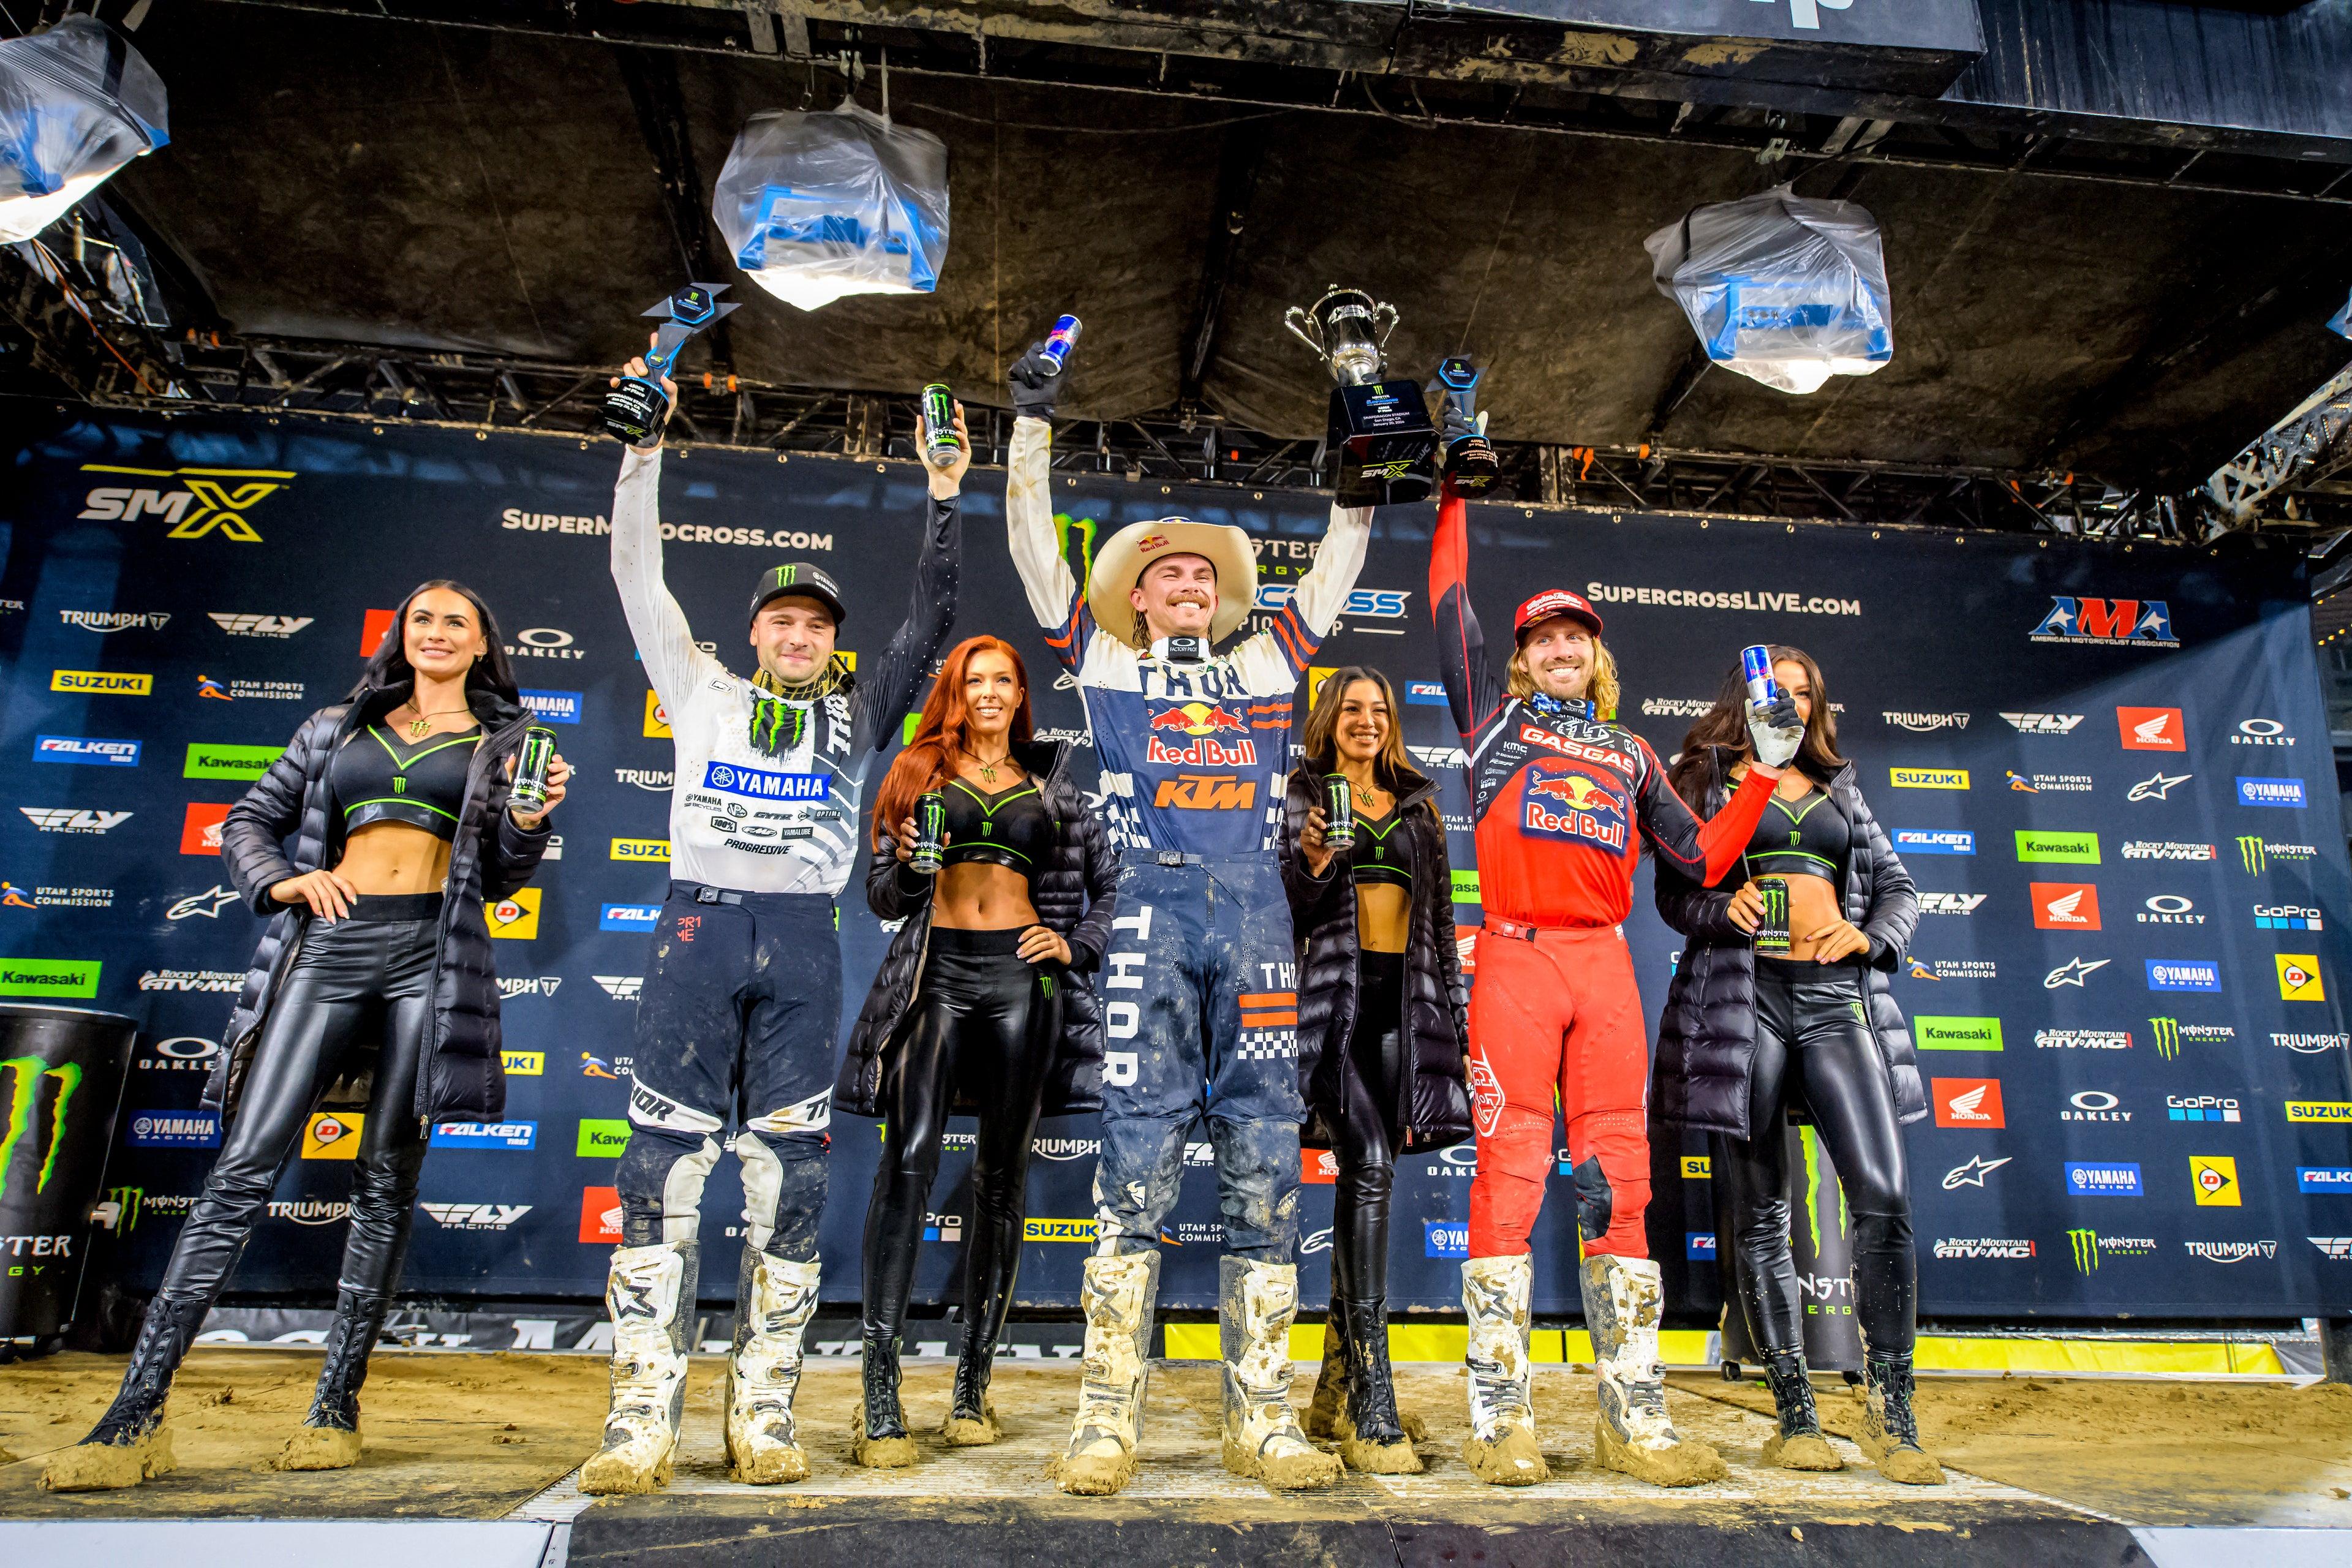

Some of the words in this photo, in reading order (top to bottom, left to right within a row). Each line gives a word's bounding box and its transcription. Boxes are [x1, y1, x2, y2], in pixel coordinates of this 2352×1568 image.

[633, 399, 652, 412] STADIUM
[1360, 464, 1411, 478] SMX
[1455, 478, 1490, 487] SMX
[77, 479, 279, 541] SMX
[502, 508, 833, 551] SUPERMOCROSS.COM
[61, 610, 146, 633] TRIUMPH
[207, 612, 315, 633] FLY
[2029, 596, 2180, 641] AMA
[2132, 639, 2180, 648] ASSOCIATION
[504, 646, 585, 660] OAKLEY
[59, 675, 143, 690] SUZUKI
[231, 680, 260, 690] UTAH
[264, 681, 304, 691] SPORTS
[1139, 664, 1249, 698] THOR
[230, 689, 303, 699] COMMISSION
[519, 696, 575, 712] YAMAHA
[1656, 698, 1684, 707] ROCKY
[1883, 712, 1953, 731] TRIUMPH
[1999, 712, 2084, 729] FLY
[1050, 727, 1081, 737] ROCKY
[40, 739, 137, 755] FALKEN
[1503, 741, 1528, 753] KMC
[2231, 735, 2296, 746] OAKLEY
[1148, 737, 1202, 766] Red
[1206, 739, 1257, 766] Bull
[1523, 727, 1634, 775] GASGAS
[198, 756, 271, 769] Kawasak
[615, 769, 674, 791] TRIUM
[737, 771, 823, 797] YAMAHA
[1896, 772, 1962, 784] SUZUKI
[1155, 775, 1256, 809] KTM
[2035, 783, 2092, 791] COMMISSION
[2256, 785, 2301, 797] YAMAHA
[693, 794, 722, 806] YAMAHA
[692, 803, 722, 812] BICYCLES
[19, 807, 134, 828] FLY
[753, 812, 793, 820] GYTR
[714, 819, 734, 830] 100%
[1527, 801, 1577, 834] Red
[1579, 815, 1625, 849] Bull
[743, 827, 777, 837] FMF
[1898, 832, 1971, 844] FALKEN
[618, 844, 671, 856] SUZU
[724, 838, 791, 855] PROGRESSIVE
[2026, 842, 2089, 853] Kawasaki
[2136, 841, 2163, 850] ROCKY
[2165, 842, 2209, 851] MOUNTAIN
[2264, 843, 2318, 855] MONSTER
[36, 887, 68, 896] UTAH
[71, 888, 115, 898] SPORTS
[34, 897, 111, 907] COMMISSION
[608, 908, 661, 921] FALK
[2253, 905, 2321, 917] GoPro
[2136, 913, 2206, 924] OAKLEY
[1757, 929, 1790, 938] MONSTER
[2, 970, 86, 986] Kawasaki
[159, 970, 197, 979] ROCKY
[197, 971, 246, 981] MOUNTA
[1261, 963, 1297, 990] THO
[1936, 970, 1996, 979] COMMISSION
[2167, 967, 2214, 981] YAMAHA
[1102, 906, 1152, 1087] THOR
[1926, 1028, 1991, 1040] Kawasaki
[2049, 1029, 2076, 1038] ROCKY
[2079, 1030, 2125, 1039] MOUNTAIN
[2179, 1025, 2234, 1036] MONSTER
[2269, 1033, 2340, 1054] TRIUMPH
[139, 1059, 214, 1071] OAKLE
[2166, 1095, 2239, 1109] GoPro
[2060, 1110, 2132, 1121] OAKLEY
[2291, 1106, 2352, 1118] SUZUK
[152, 1119, 214, 1135] YAMAHA
[439, 1122, 532, 1138] FALKEN
[1031, 1138, 1101, 1161] RIUMPH
[1427, 1166, 1478, 1176] OAKL
[2086, 1169, 2136, 1185] YAMAHA
[419, 1202, 533, 1224] FLY
[1025, 1223, 1098, 1237] SUZUK
[1179, 1234, 1224, 1242] COMMIS
[1948, 1237, 1978, 1248] ROCKY
[1980, 1238, 2029, 1248] MOUNTAIN
[2098, 1236, 2157, 1250] MONSTER
[2184, 1242, 2260, 1263] TRIUMPH
